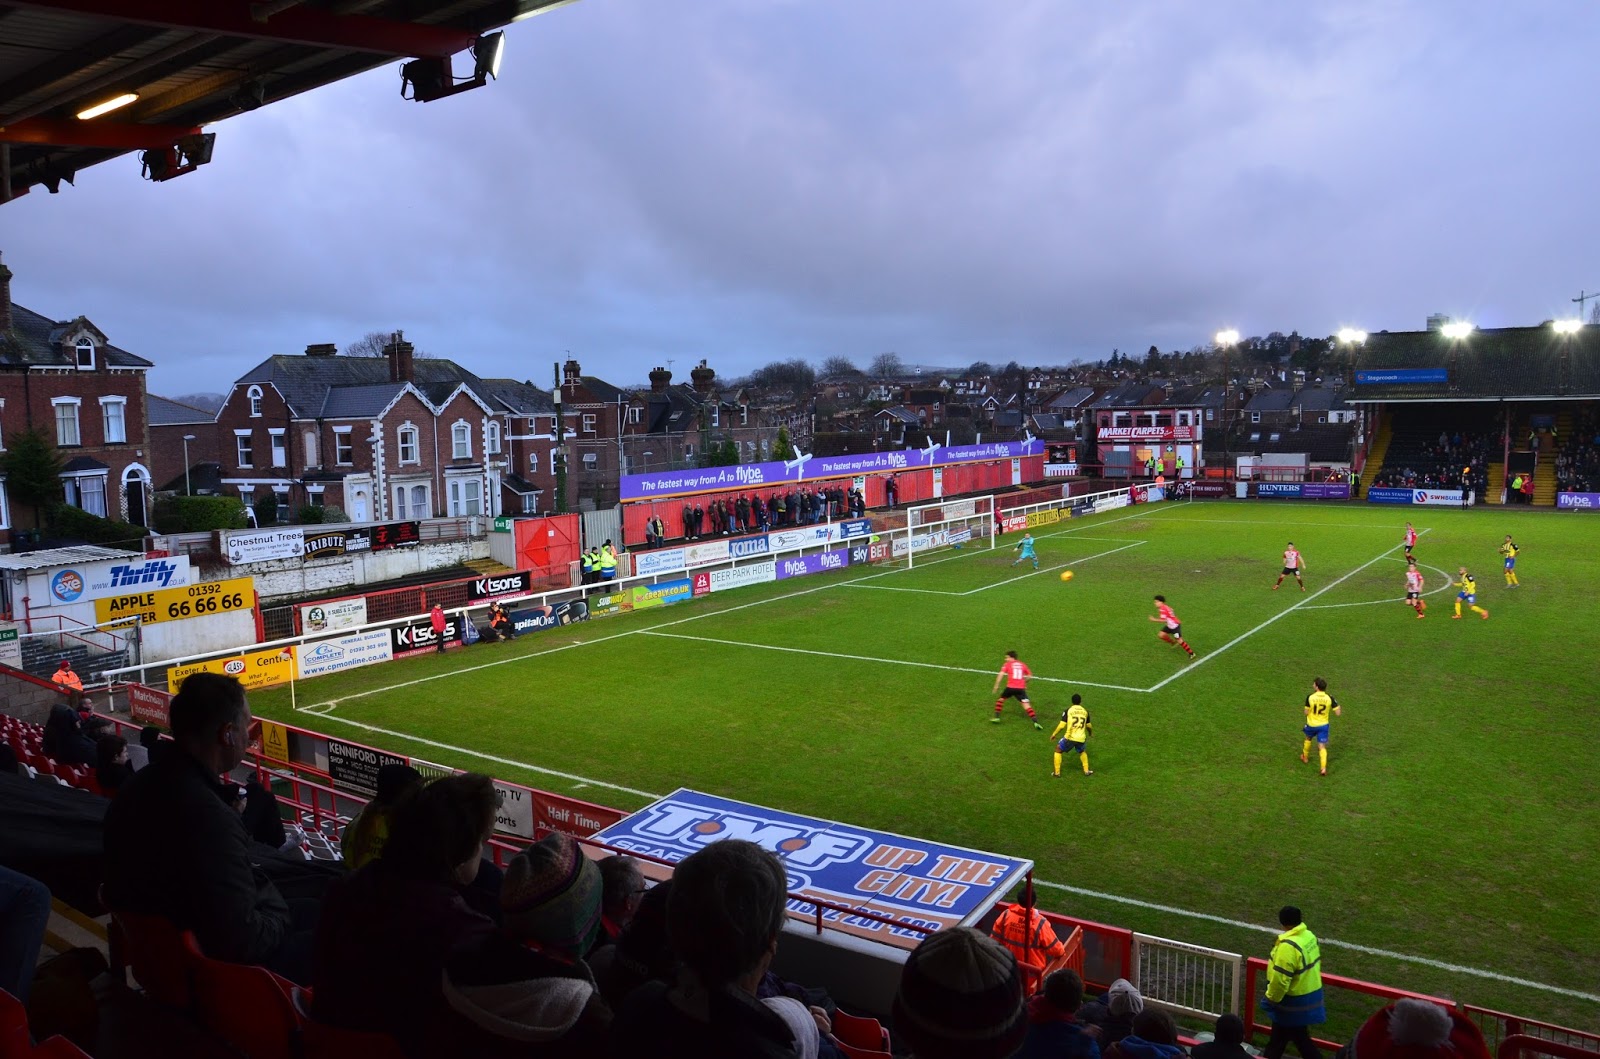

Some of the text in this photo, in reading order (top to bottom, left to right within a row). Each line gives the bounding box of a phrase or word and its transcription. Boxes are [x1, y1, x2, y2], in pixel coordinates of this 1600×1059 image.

[1098, 427, 1131, 438] MARKET
[1131, 427, 1164, 438] CARPETS
[956, 450, 969, 458] fastest
[986, 446, 990, 454] A
[833, 462, 850, 470] fastest
[852, 462, 862, 470] way
[862, 460, 874, 468] from
[874, 456, 881, 466] A
[642, 481, 656, 490] The
[658, 476, 682, 488] fastest
[684, 476, 698, 488] way
[700, 474, 716, 486] from
[718, 470, 726, 483] A
[727, 474, 734, 482] to
[494, 520, 505, 528] Exit
[1009, 516, 1026, 528] CARPETS
[230, 532, 302, 548] Chestnut Trees
[305, 536, 344, 554] TRIBUTE
[853, 543, 888, 562] sky BET
[712, 564, 774, 583] DEER PARK HOTEL
[56, 578, 80, 594] exe
[188, 584, 221, 597] 01392
[476, 576, 522, 596] Kitsons
[110, 594, 156, 612] APPLE
[168, 592, 243, 618] 66 66 66
[597, 592, 626, 608] SUBWAY
[110, 606, 156, 618] CENTRAL TAXIS
[341, 632, 386, 645] GENERAL BUILDERS
[397, 622, 456, 648] Kitsos
[304, 652, 388, 675] www.cpmonline.co.uk
[306, 652, 342, 663] COMPLETE
[174, 666, 200, 677] Exeter
[226, 662, 243, 672] GLASS
[134, 690, 164, 708] Matchday
[134, 704, 168, 724] Hospitality
[1314, 704, 1326, 716] 12
[1072, 716, 1086, 729] 23
[328, 742, 376, 765] KENNIFORD
[330, 756, 344, 765] SHOP
[510, 790, 521, 801] TV
[548, 806, 570, 823] Half
[574, 812, 600, 832] Time
[864, 844, 1010, 886] UP THE
[854, 870, 970, 908] CITY!
